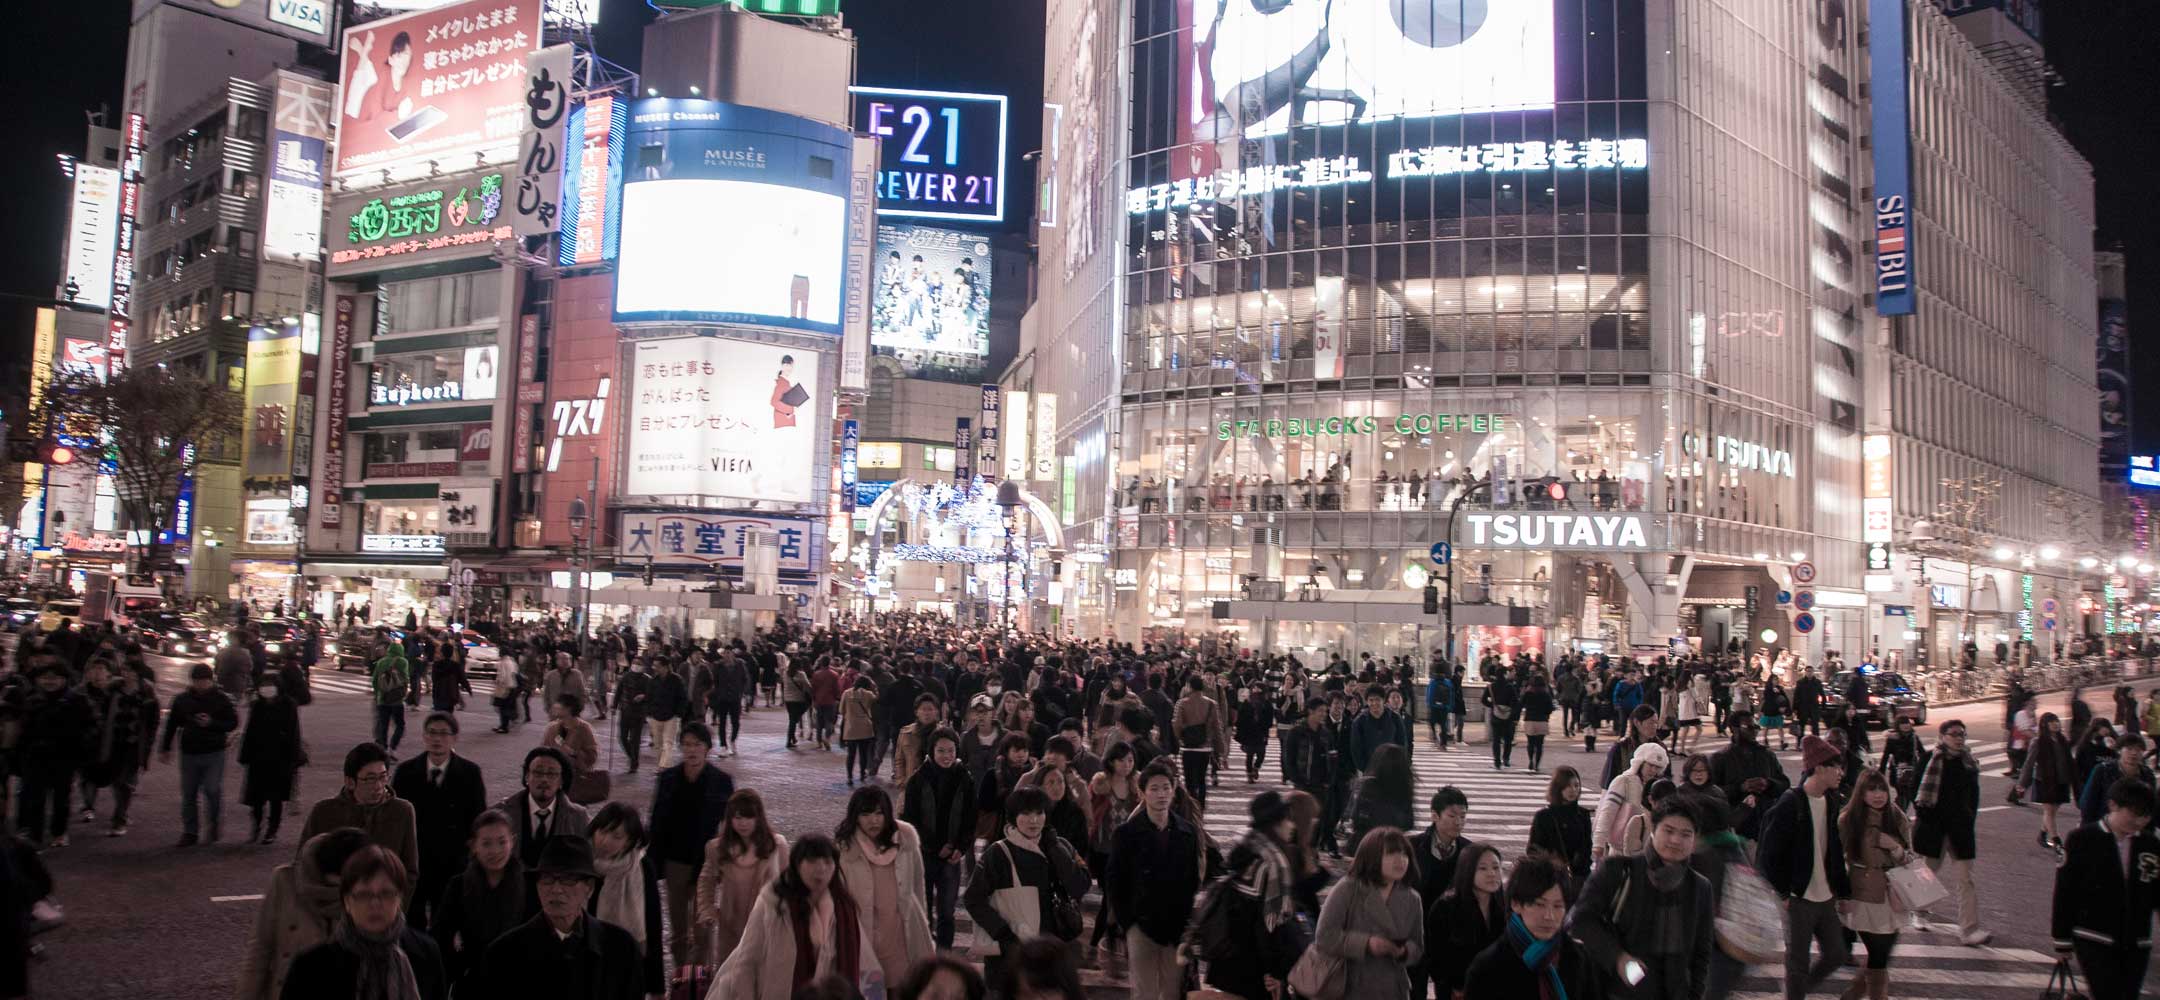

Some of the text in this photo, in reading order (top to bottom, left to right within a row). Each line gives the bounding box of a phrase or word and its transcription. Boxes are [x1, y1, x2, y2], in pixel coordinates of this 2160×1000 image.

[277, 0, 323, 25] VISA
[425, 5, 518, 43] メイクしたまま
[423, 30, 529, 71] 寝ちゃわなかった
[672, 112, 720, 121] Channel
[516, 67, 564, 228] もんじゃ
[704, 146, 766, 162] MUSÉE
[704, 160, 766, 170] PLATINUM
[964, 175, 993, 205] 21
[1876, 194, 1907, 294] SEIBU
[643, 361, 714, 379] 恋も仕事も
[375, 381, 459, 406] Euphoria
[641, 387, 710, 404] がんばった
[1217, 412, 1505, 440] STARBUCKS COFFEE
[1717, 435, 1794, 478] TSUTAYA
[1467, 514, 1647, 547] TSUTAYA
